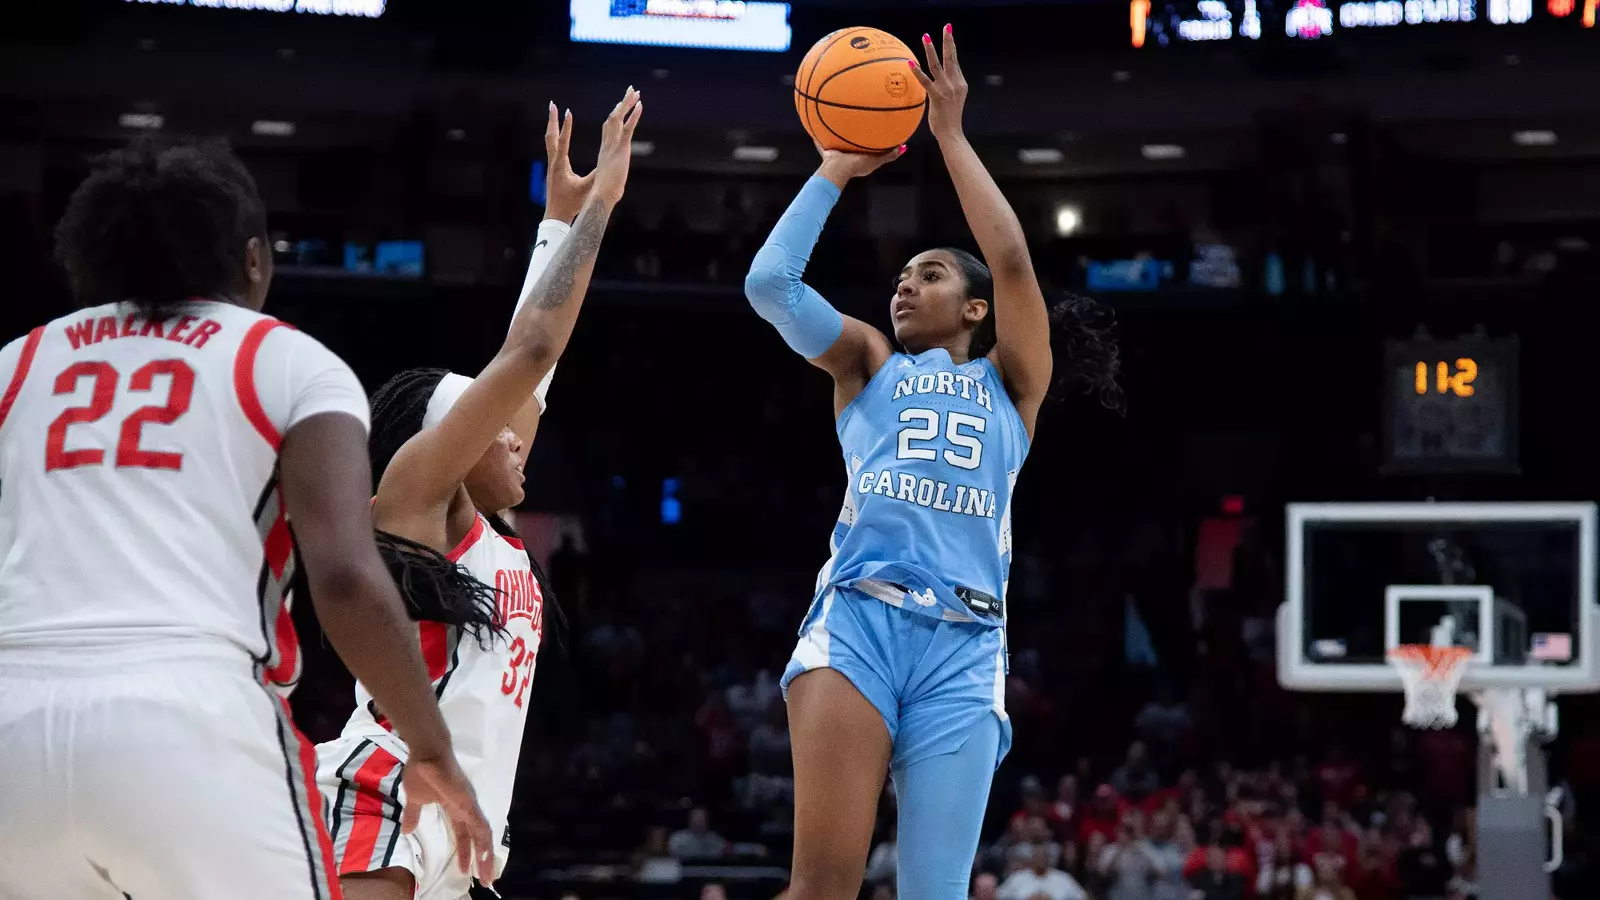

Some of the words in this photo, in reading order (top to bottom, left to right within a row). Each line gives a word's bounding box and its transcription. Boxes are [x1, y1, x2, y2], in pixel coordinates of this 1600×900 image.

[64, 312, 222, 350] WALKER
[45, 358, 196, 473] 22
[892, 371, 993, 413] NORTH
[896, 407, 987, 470] 25
[857, 469, 996, 520] CAROLINA
